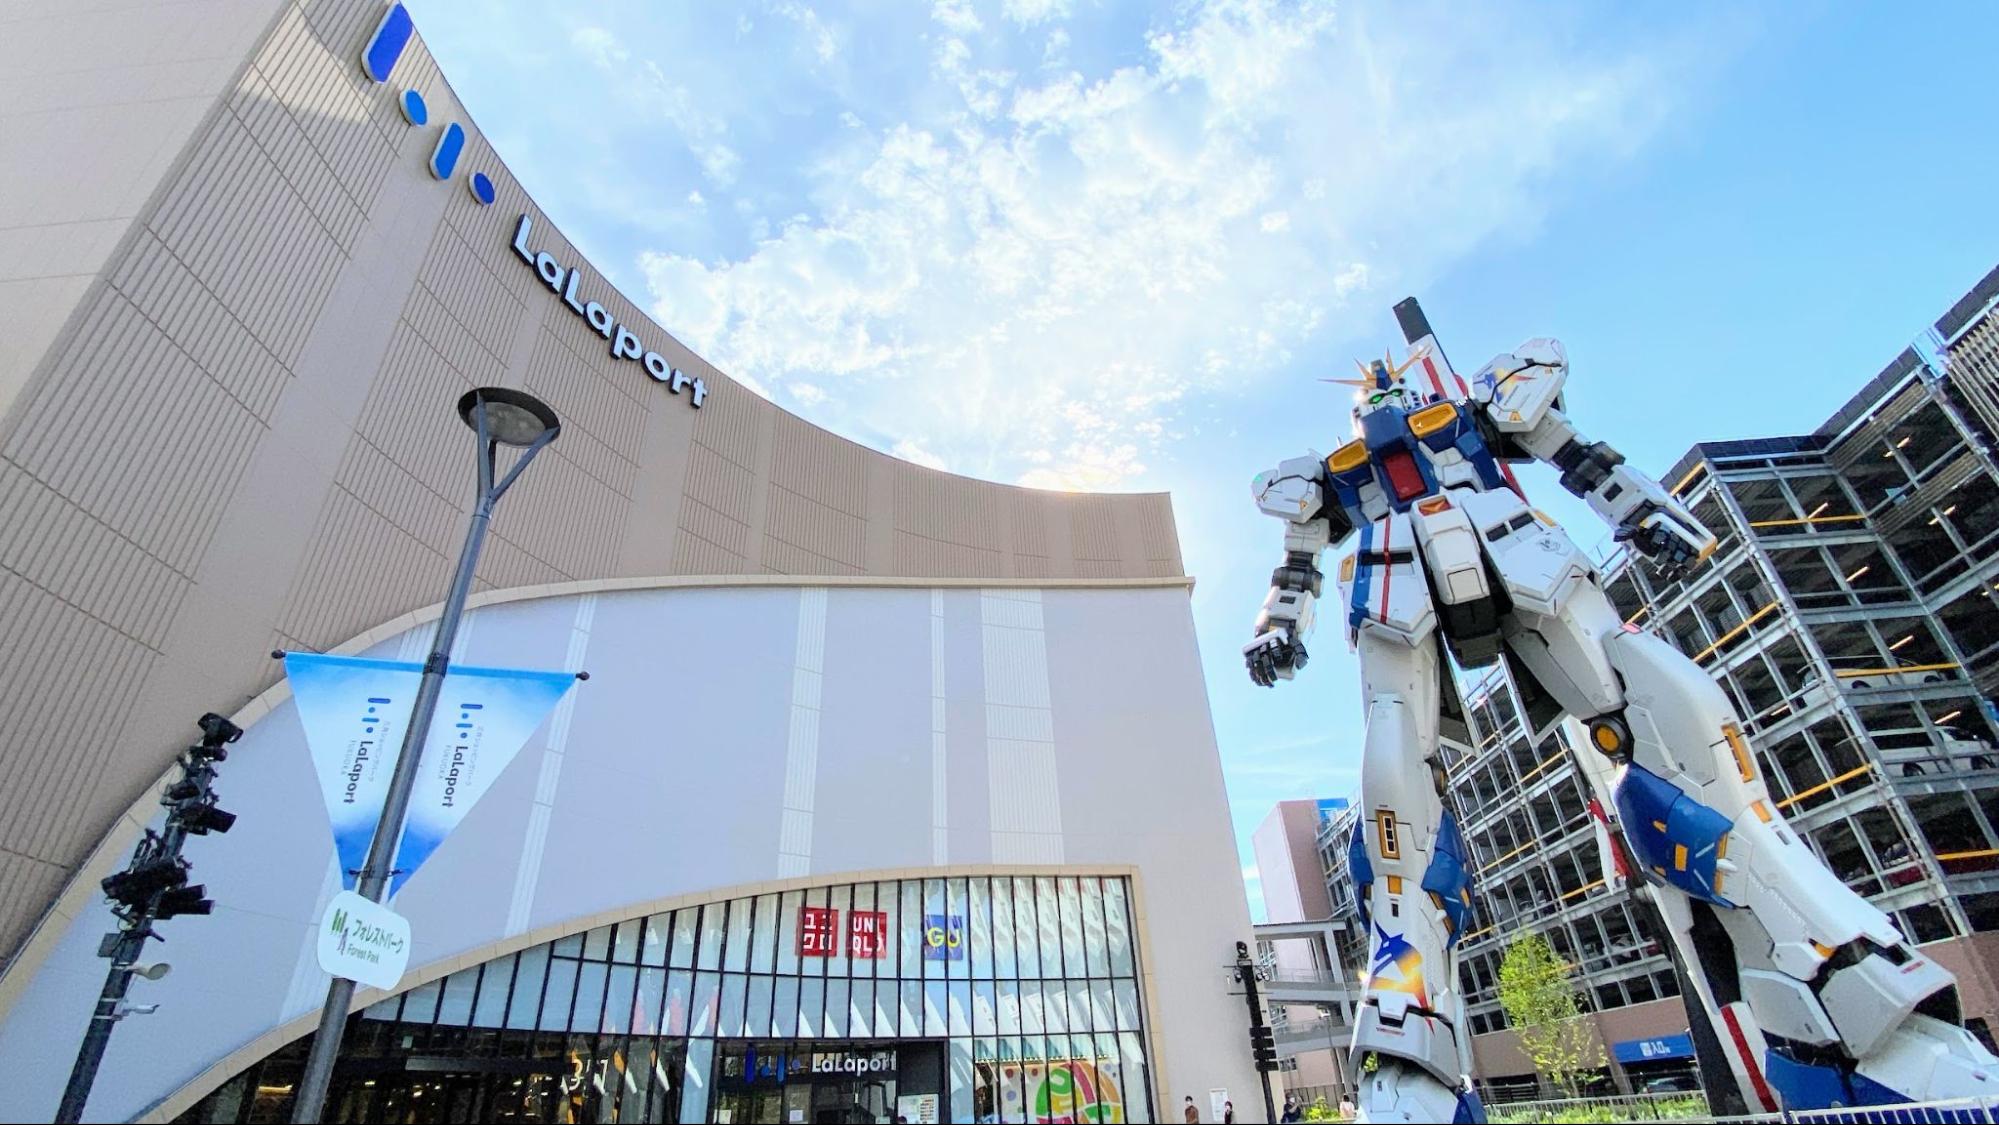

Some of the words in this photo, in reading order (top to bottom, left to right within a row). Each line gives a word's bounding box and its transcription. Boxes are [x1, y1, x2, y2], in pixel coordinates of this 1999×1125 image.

[511, 214, 707, 408] LaLaport
[343, 741, 374, 804] LaLaport
[442, 746, 469, 808] LaLaport
[352, 919, 404, 953] フォレストパーク
[927, 927, 961, 948] GU
[811, 1050, 897, 1077] LaLaport
